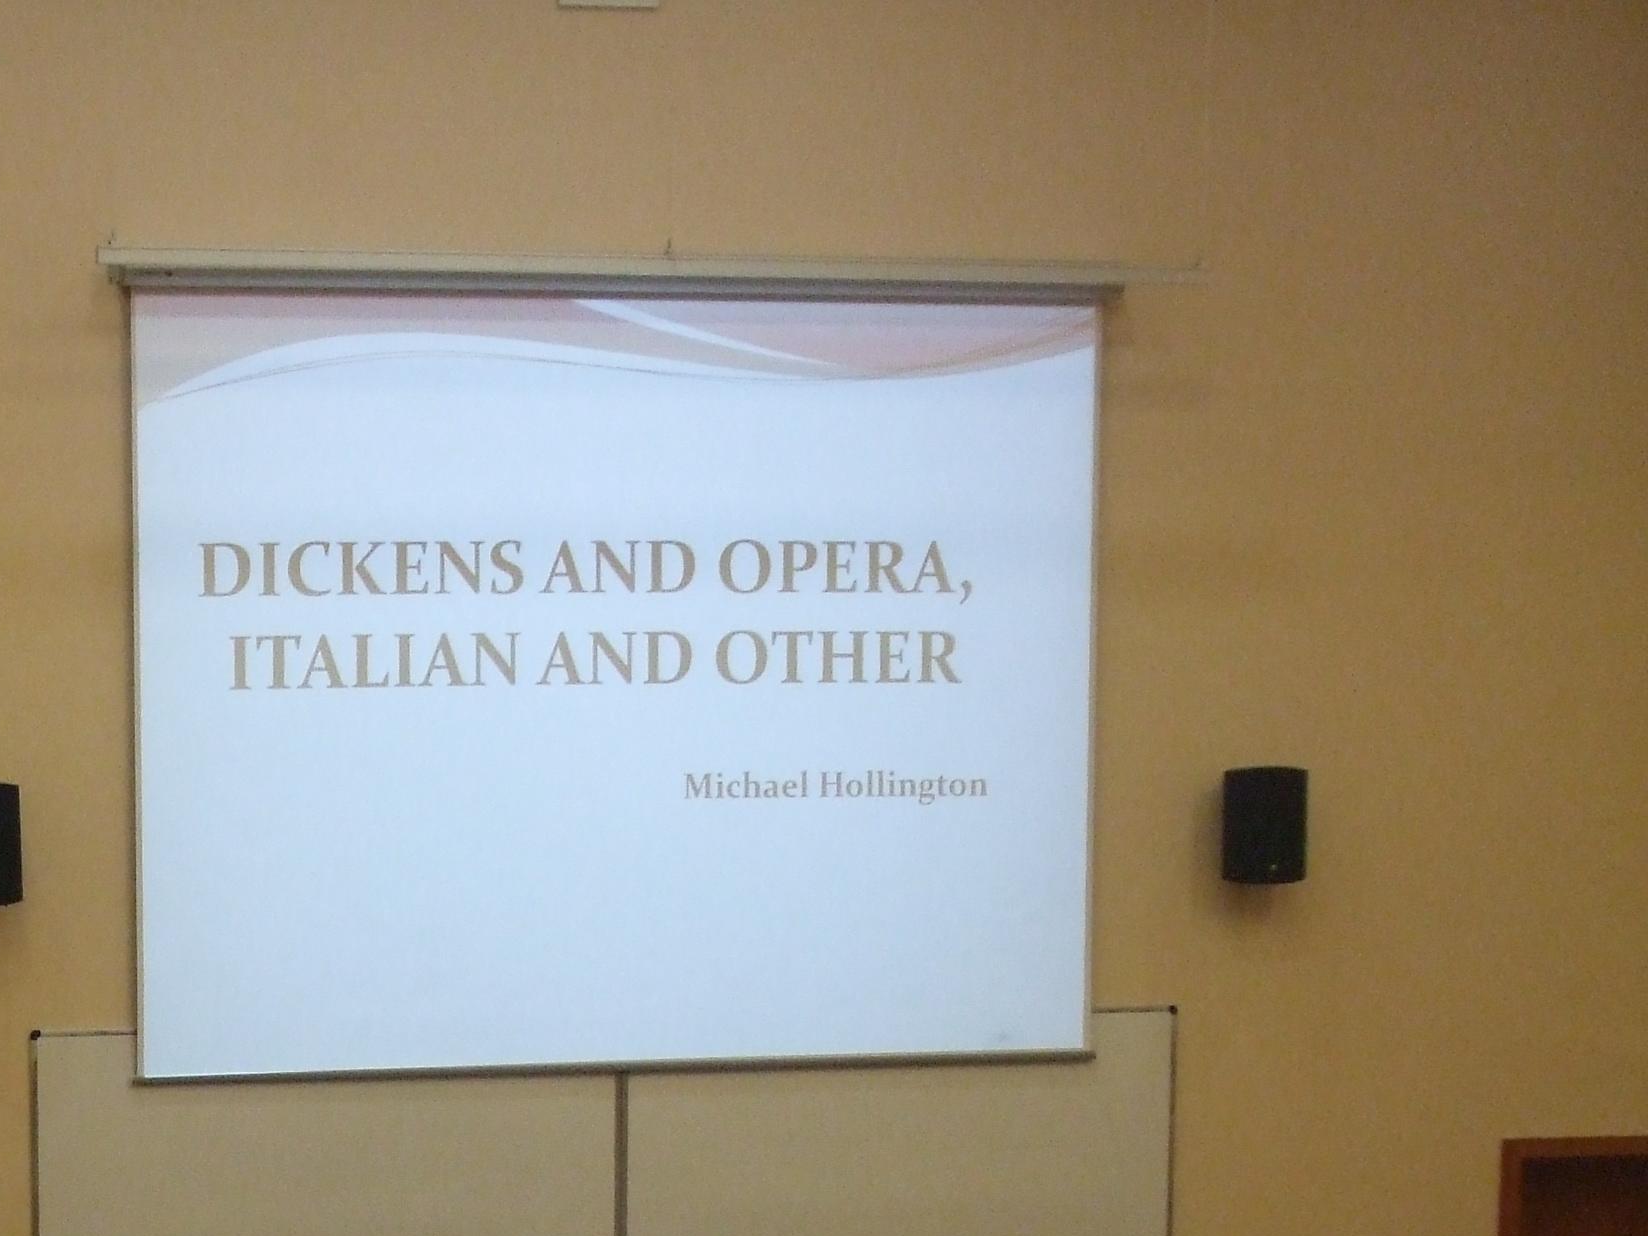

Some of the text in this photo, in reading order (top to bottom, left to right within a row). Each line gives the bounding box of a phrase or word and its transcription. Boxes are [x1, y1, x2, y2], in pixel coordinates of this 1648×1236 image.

[198, 539, 973, 604] DICKENS AND OPERA,
[228, 630, 963, 691] ITALIAN AND OTHER
[684, 770, 989, 806] Michael Hollington
